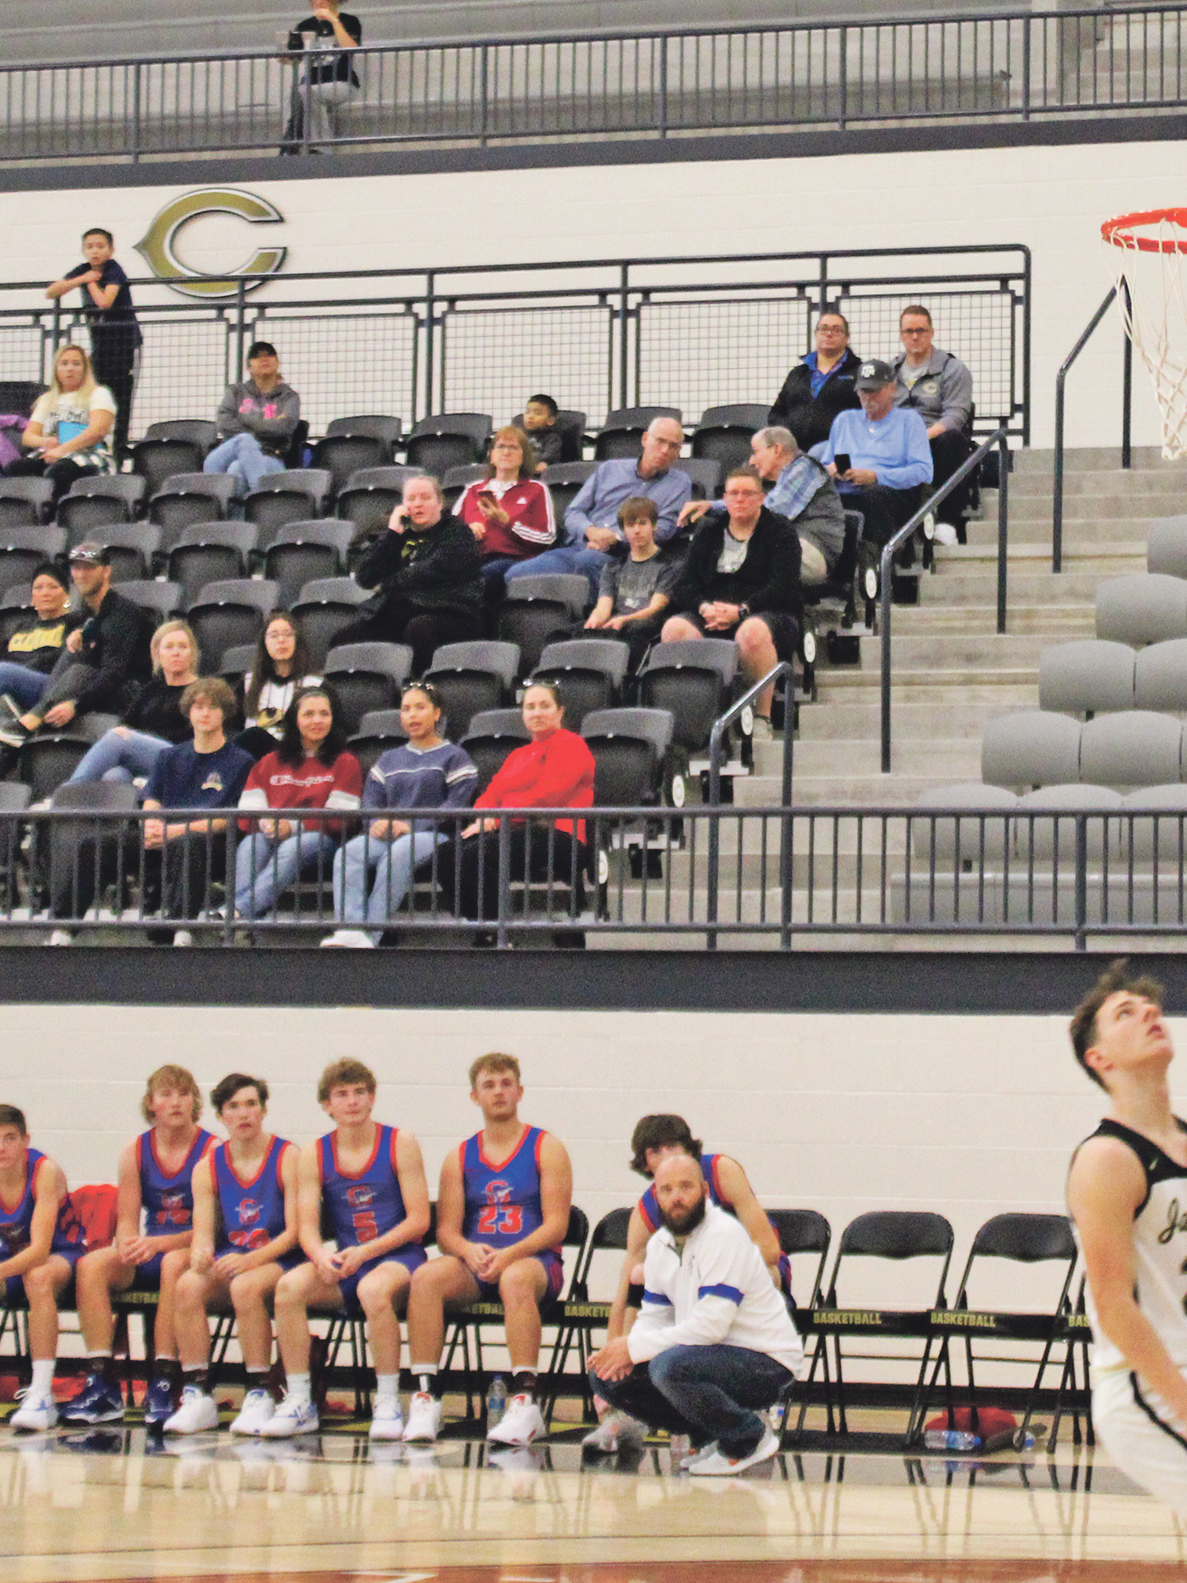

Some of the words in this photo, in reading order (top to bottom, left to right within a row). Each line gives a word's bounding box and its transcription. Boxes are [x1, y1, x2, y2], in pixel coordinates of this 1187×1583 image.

[132, 187, 288, 299] C
[352, 1210, 378, 1244] 5
[477, 1205, 523, 1235] 23
[813, 1312, 882, 1325] BASKETBALL
[930, 1312, 996, 1327] BASKETBALL
